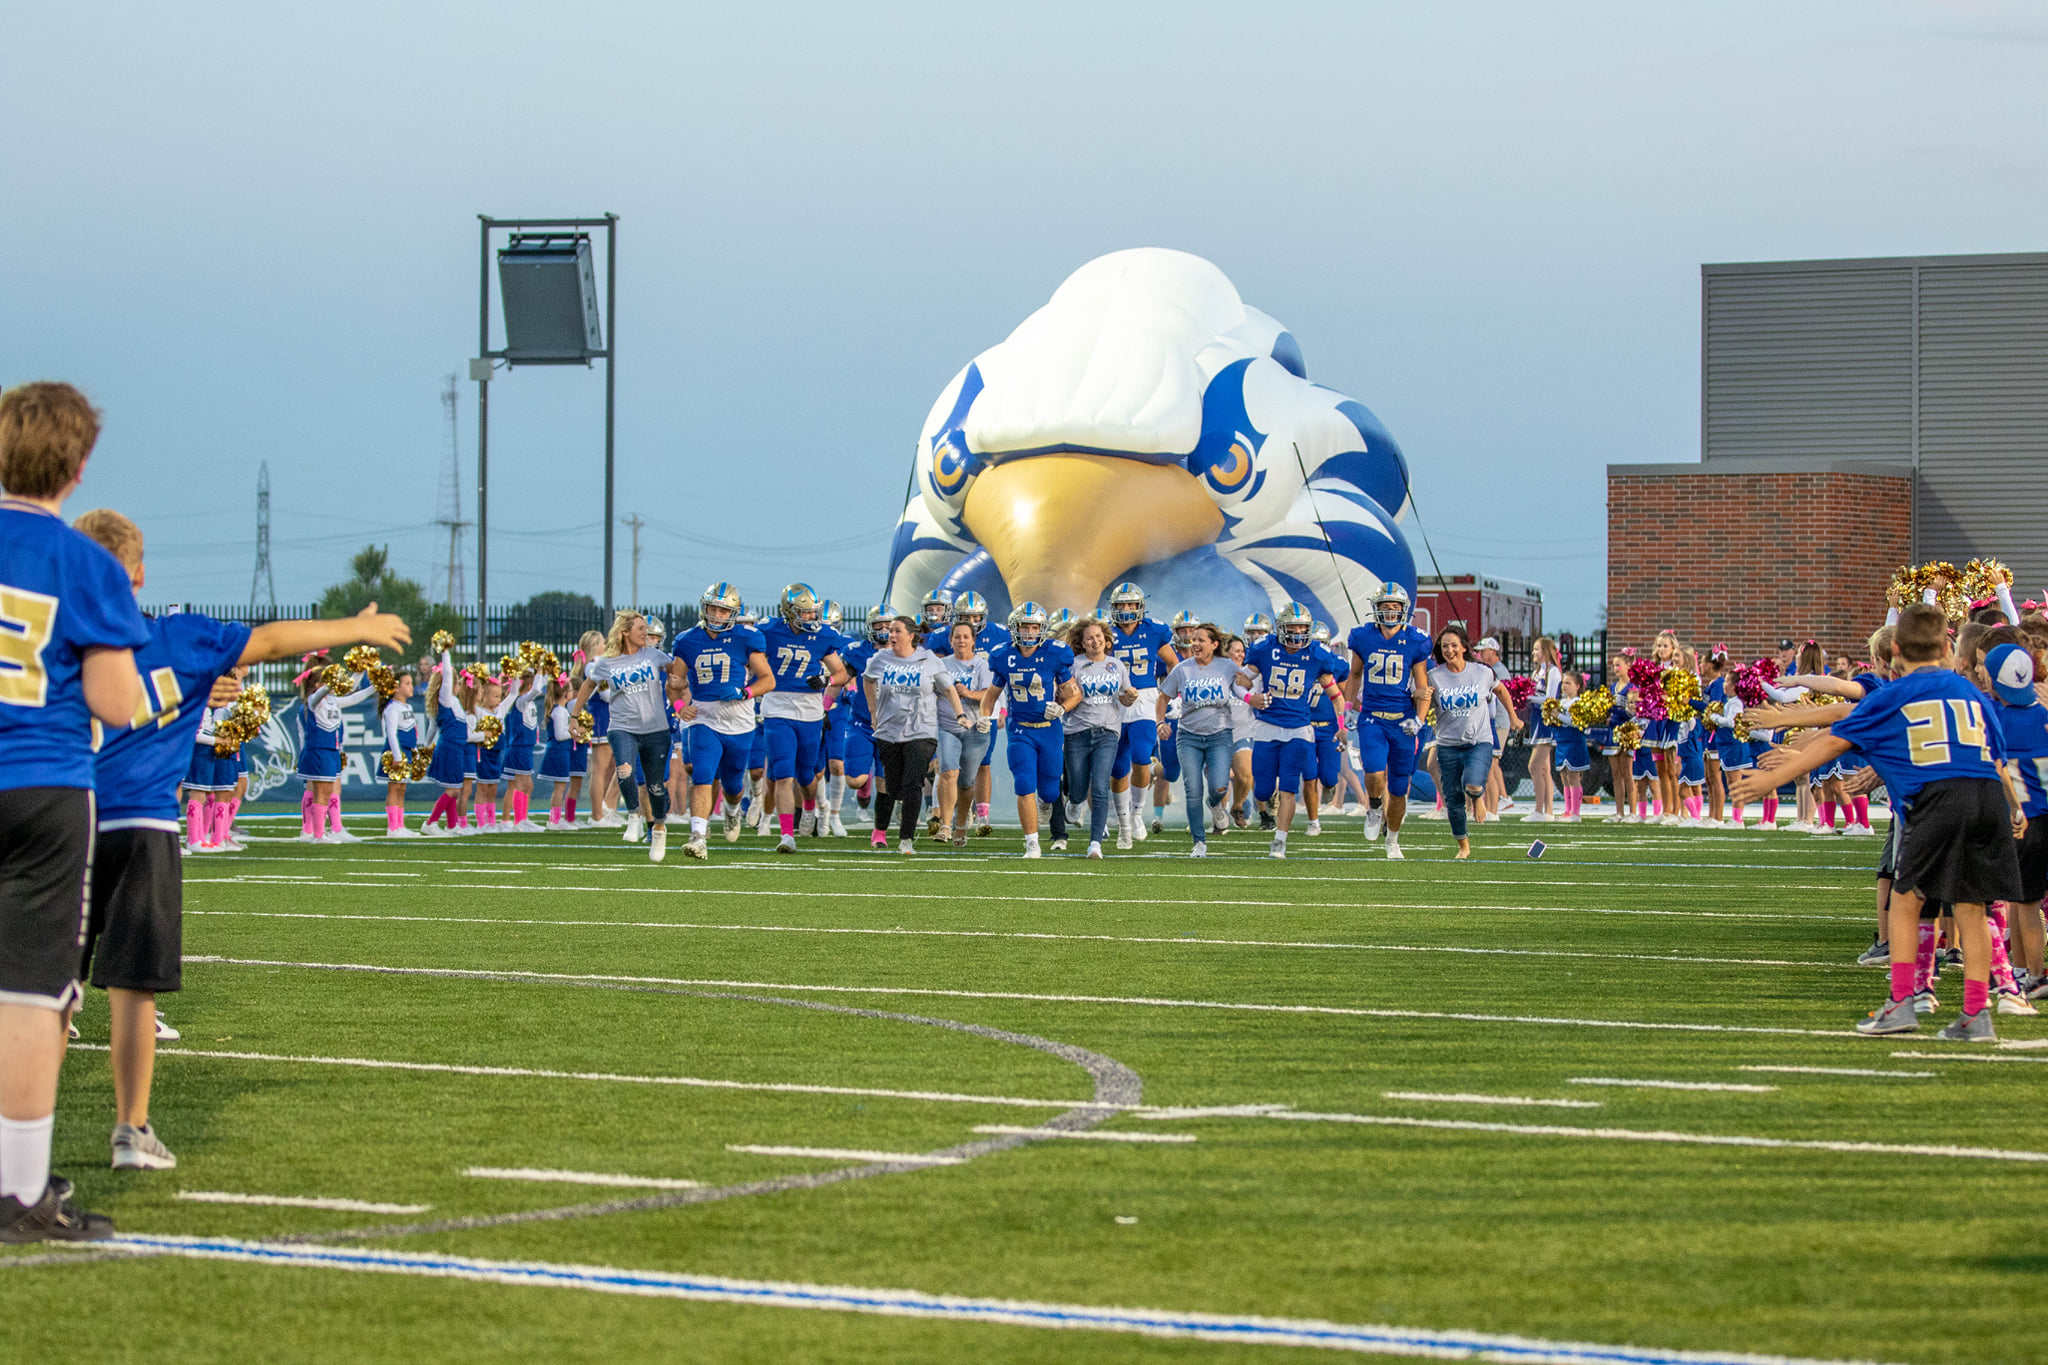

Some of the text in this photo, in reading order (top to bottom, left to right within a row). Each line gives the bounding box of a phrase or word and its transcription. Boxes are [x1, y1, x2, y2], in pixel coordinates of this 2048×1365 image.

[694, 652, 731, 684] 67
[777, 647, 811, 678] 77
[1007, 655, 1016, 667] C
[1114, 648, 1148, 676] 55
[1272, 648, 1280, 660] C
[1368, 652, 1404, 685] 20
[627, 683, 649, 699] 2022
[1008, 672, 1046, 702] 54
[1268, 665, 1306, 700] 58
[1092, 696, 1113, 705] 2022
[1451, 709, 1472, 718] 2022
[1901, 699, 1995, 767] 24
